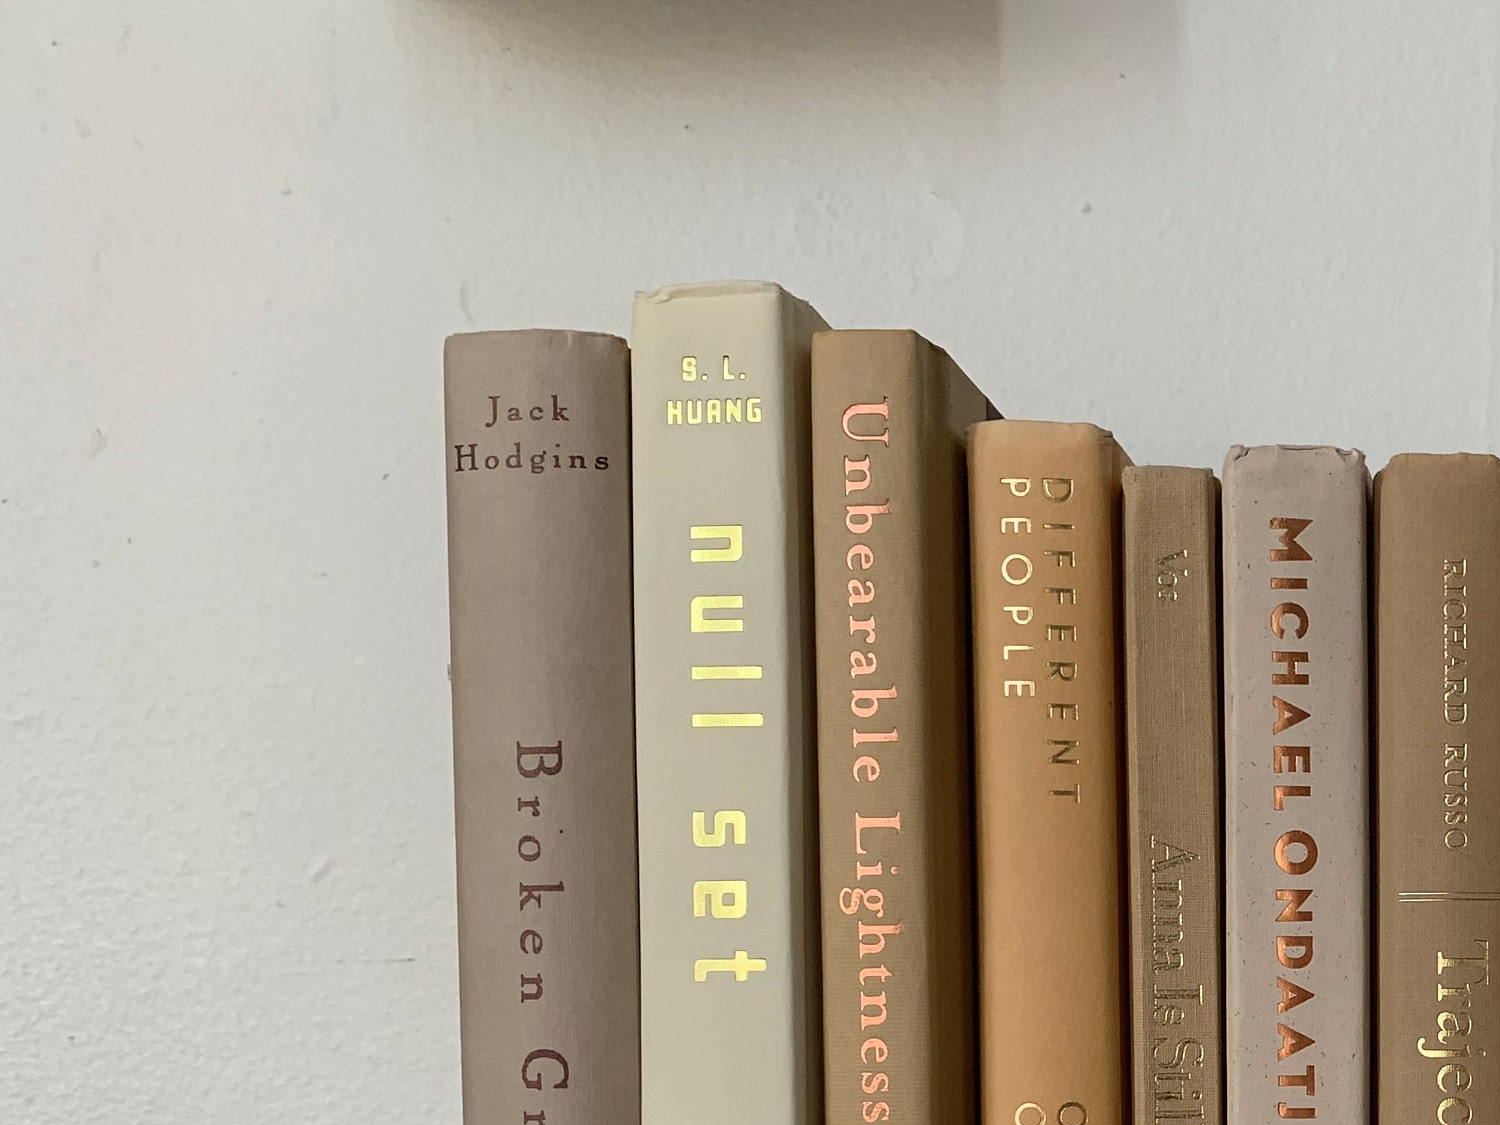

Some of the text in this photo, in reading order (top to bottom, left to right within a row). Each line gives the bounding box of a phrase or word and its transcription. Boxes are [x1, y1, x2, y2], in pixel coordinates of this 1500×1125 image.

[454, 444, 611, 474] Hodgins
[485, 395, 569, 428] Jack
[667, 397, 762, 426] HUANG
[682, 355, 747, 382] S. L.
[840, 396, 898, 783] Unbearable
[1000, 477, 1035, 697] PEOPLE
[1041, 477, 1081, 804] DIFFERENT
[1269, 516, 1313, 811] MICHAEL
[1443, 558, 1469, 851] RICHARD RUSSO
[515, 740, 565, 1004] Broken
[690, 524, 767, 983] null set
[839, 811, 904, 1124] Lightness
[1151, 835, 1200, 974] Anna
[1154, 984, 1203, 1026] Is
